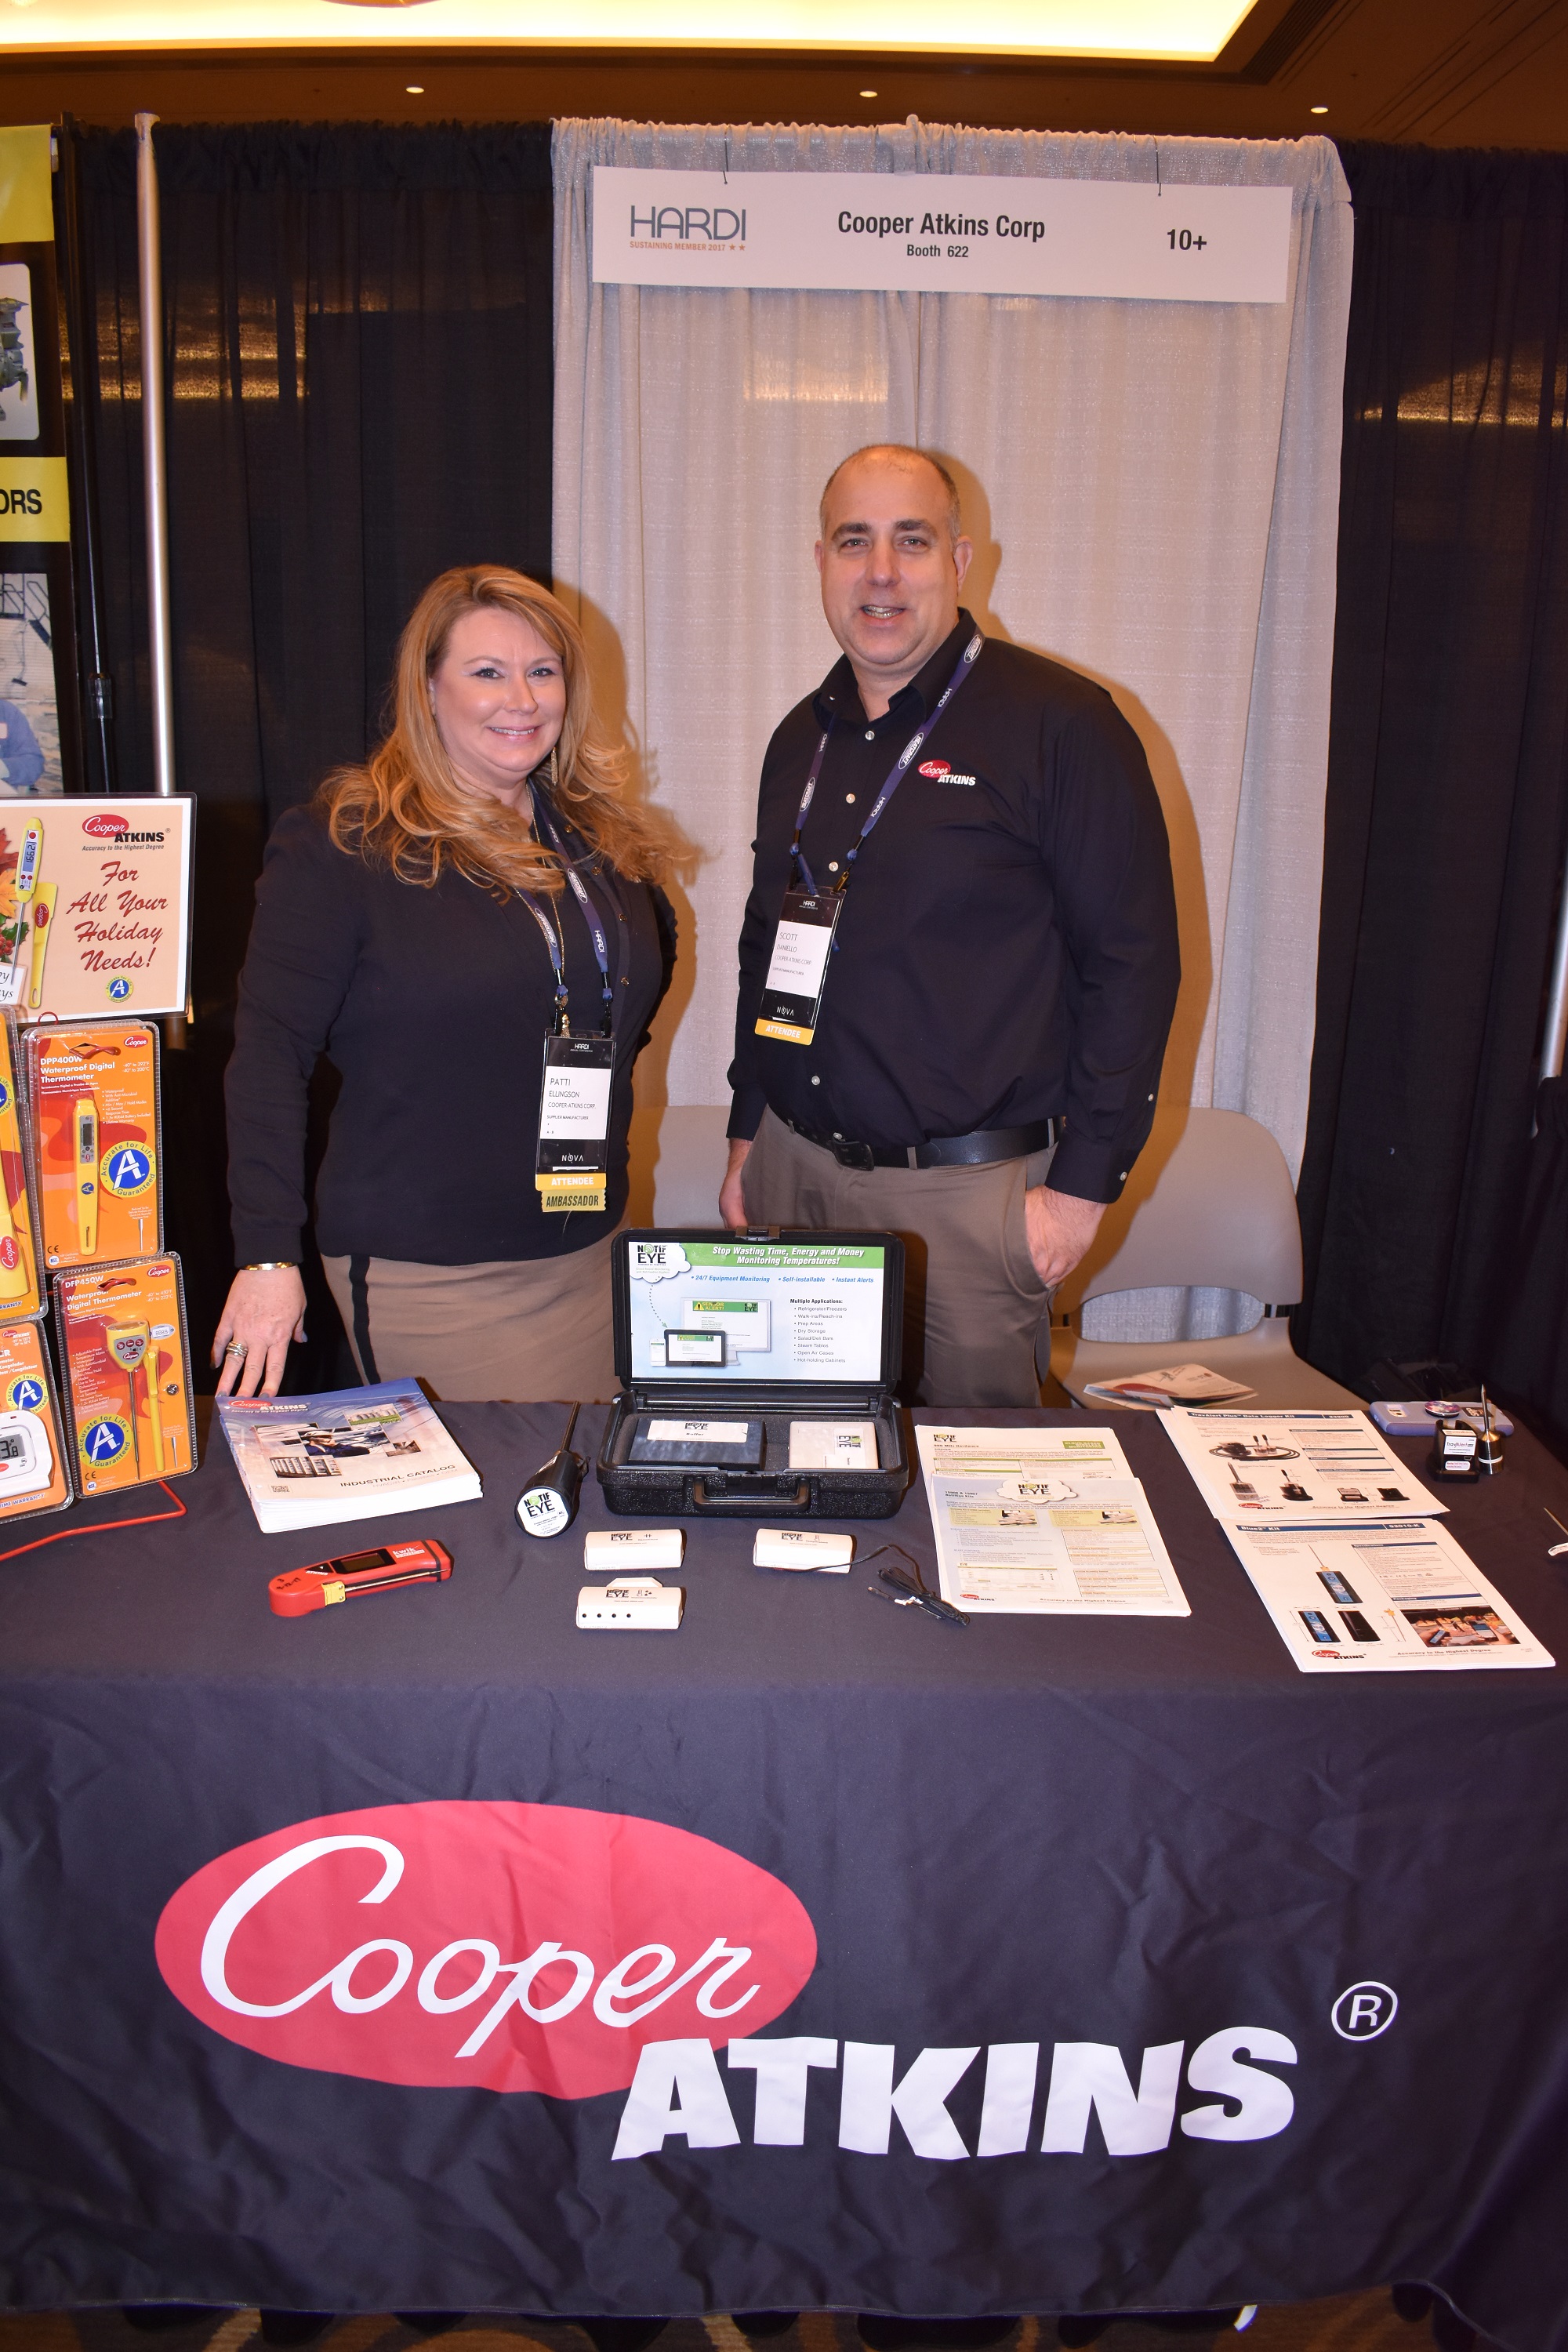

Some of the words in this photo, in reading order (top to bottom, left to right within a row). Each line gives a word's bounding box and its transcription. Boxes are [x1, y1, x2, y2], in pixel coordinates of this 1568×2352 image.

[630, 205, 746, 241] HARDI
[838, 211, 914, 238] Cooper
[920, 212, 989, 236] Atkins
[996, 215, 1045, 243] Corp
[630, 241, 673, 250] SUSTAINING
[674, 242, 706, 251] MEMBER
[1167, 228, 1207, 251] 10+
[906, 244, 941, 257] Booth
[947, 245, 969, 258] 622
[919, 761, 949, 775] Cooper
[937, 774, 976, 786] ATKINS
[85, 816, 125, 836] Cooper
[114, 832, 165, 843] ATKINS
[100, 861, 140, 887] For
[66, 891, 108, 915] All
[117, 890, 169, 917] Your
[74, 920, 164, 945] Holiday
[779, 931, 799, 942] SCOTT
[594, 930, 605, 953] HARDI
[80, 946, 157, 972] Needs!
[776, 1006, 795, 1016] NOVA
[765, 1024, 801, 1039] ATTENDEE
[125, 1036, 147, 1047] Cooper
[40, 1056, 82, 1065] DPP400W
[40, 1064, 87, 1074] Waterproof
[89, 1062, 115, 1071] Digital
[40, 1073, 94, 1083] Thermometer
[550, 1077, 571, 1087] PATTI
[101, 1144, 123, 1176] Accurate
[141, 1145, 153, 1159] Life
[117, 1173, 155, 1196] Guaranteed
[551, 1177, 594, 1185] ATTENDEE
[546, 1195, 599, 1207] AMBASSADOR
[637, 1253, 666, 1264] EYE
[713, 1246, 731, 1255] Stop
[733, 1247, 765, 1257] Wasting
[767, 1247, 789, 1256] Time,
[791, 1247, 818, 1257] Energy
[821, 1247, 836, 1256] and
[837, 1247, 864, 1258] Money
[736, 1256, 780, 1266] Monitoring
[783, 1257, 840, 1265] Temperatures!
[147, 1267, 170, 1276] Cooper
[65, 1276, 104, 1289] DFP450W
[67, 1299, 92, 1311] Digital
[93, 1290, 143, 1305] Thermometer
[7, 1377, 22, 1402] Accurate
[34, 1376, 45, 1385] Life
[79, 1419, 98, 1452] Accurate
[114, 1414, 127, 1428] Life
[94, 1442, 131, 1468] Guaranteed
[340, 1475, 405, 1487] INDUSTRIAL
[406, 1465, 456, 1478] CATALOG
[13, 1493, 45, 1504] WARRANTY
[526, 1499, 555, 1518] EYE
[201, 1834, 761, 2059] Cooper
[612, 2026, 1298, 2161] ATKINS
